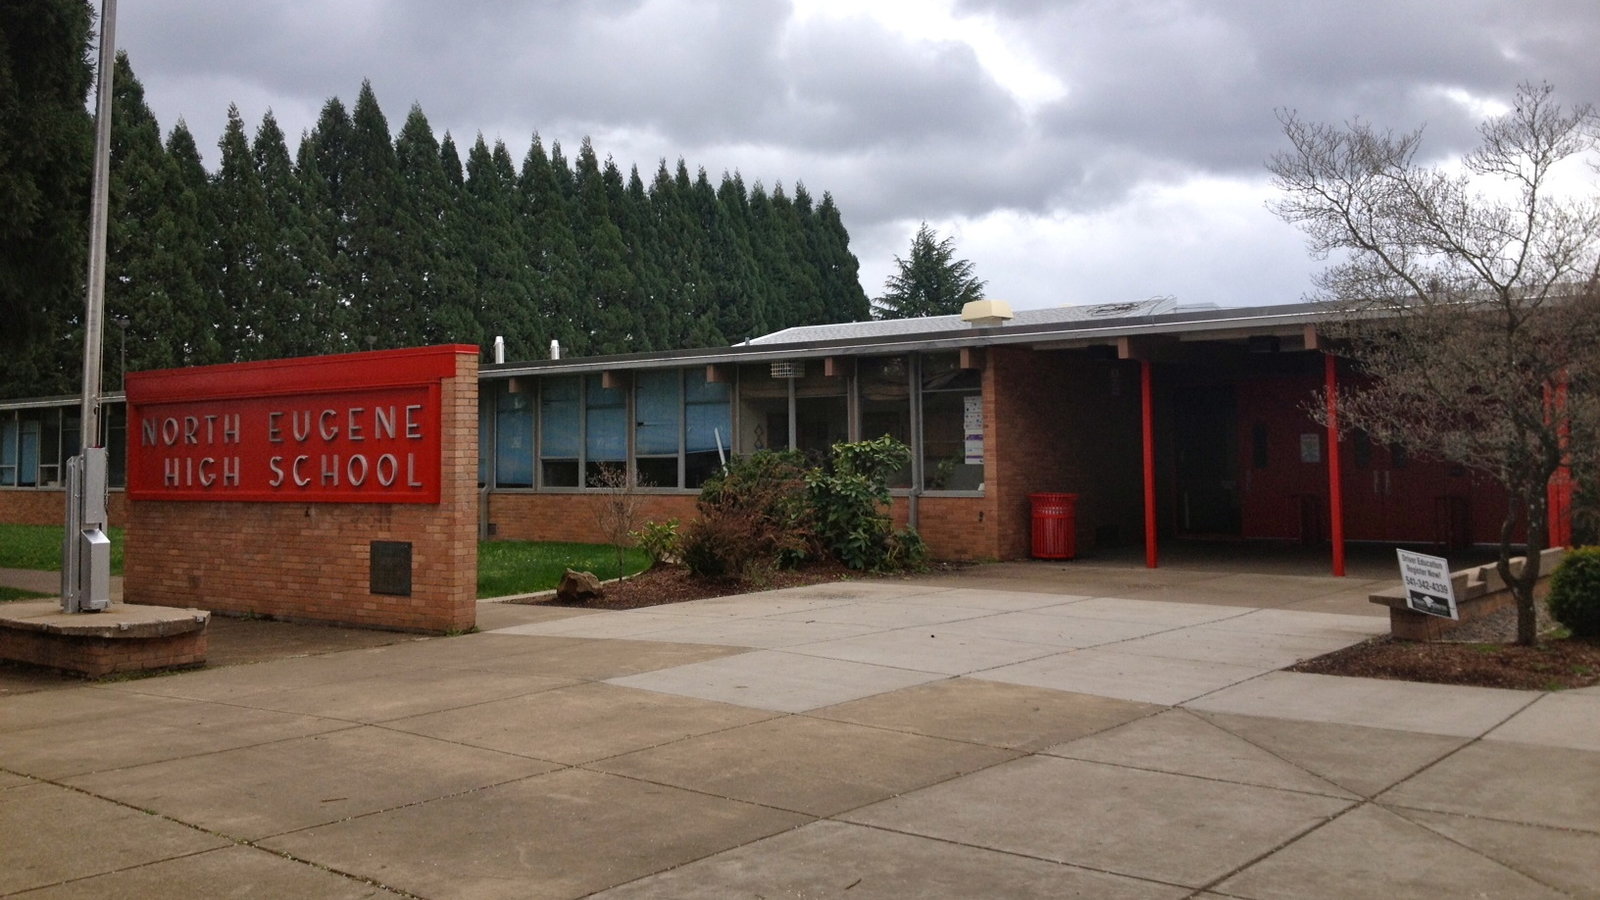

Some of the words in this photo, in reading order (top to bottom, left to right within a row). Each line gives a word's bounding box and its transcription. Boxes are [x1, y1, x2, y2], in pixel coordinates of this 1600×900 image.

[142, 414, 240, 446] NORTH
[268, 404, 422, 441] EUGENE
[164, 456, 240, 486] HIGH
[268, 453, 423, 486] SCHOOL
[1417, 557, 1442, 570] Education
